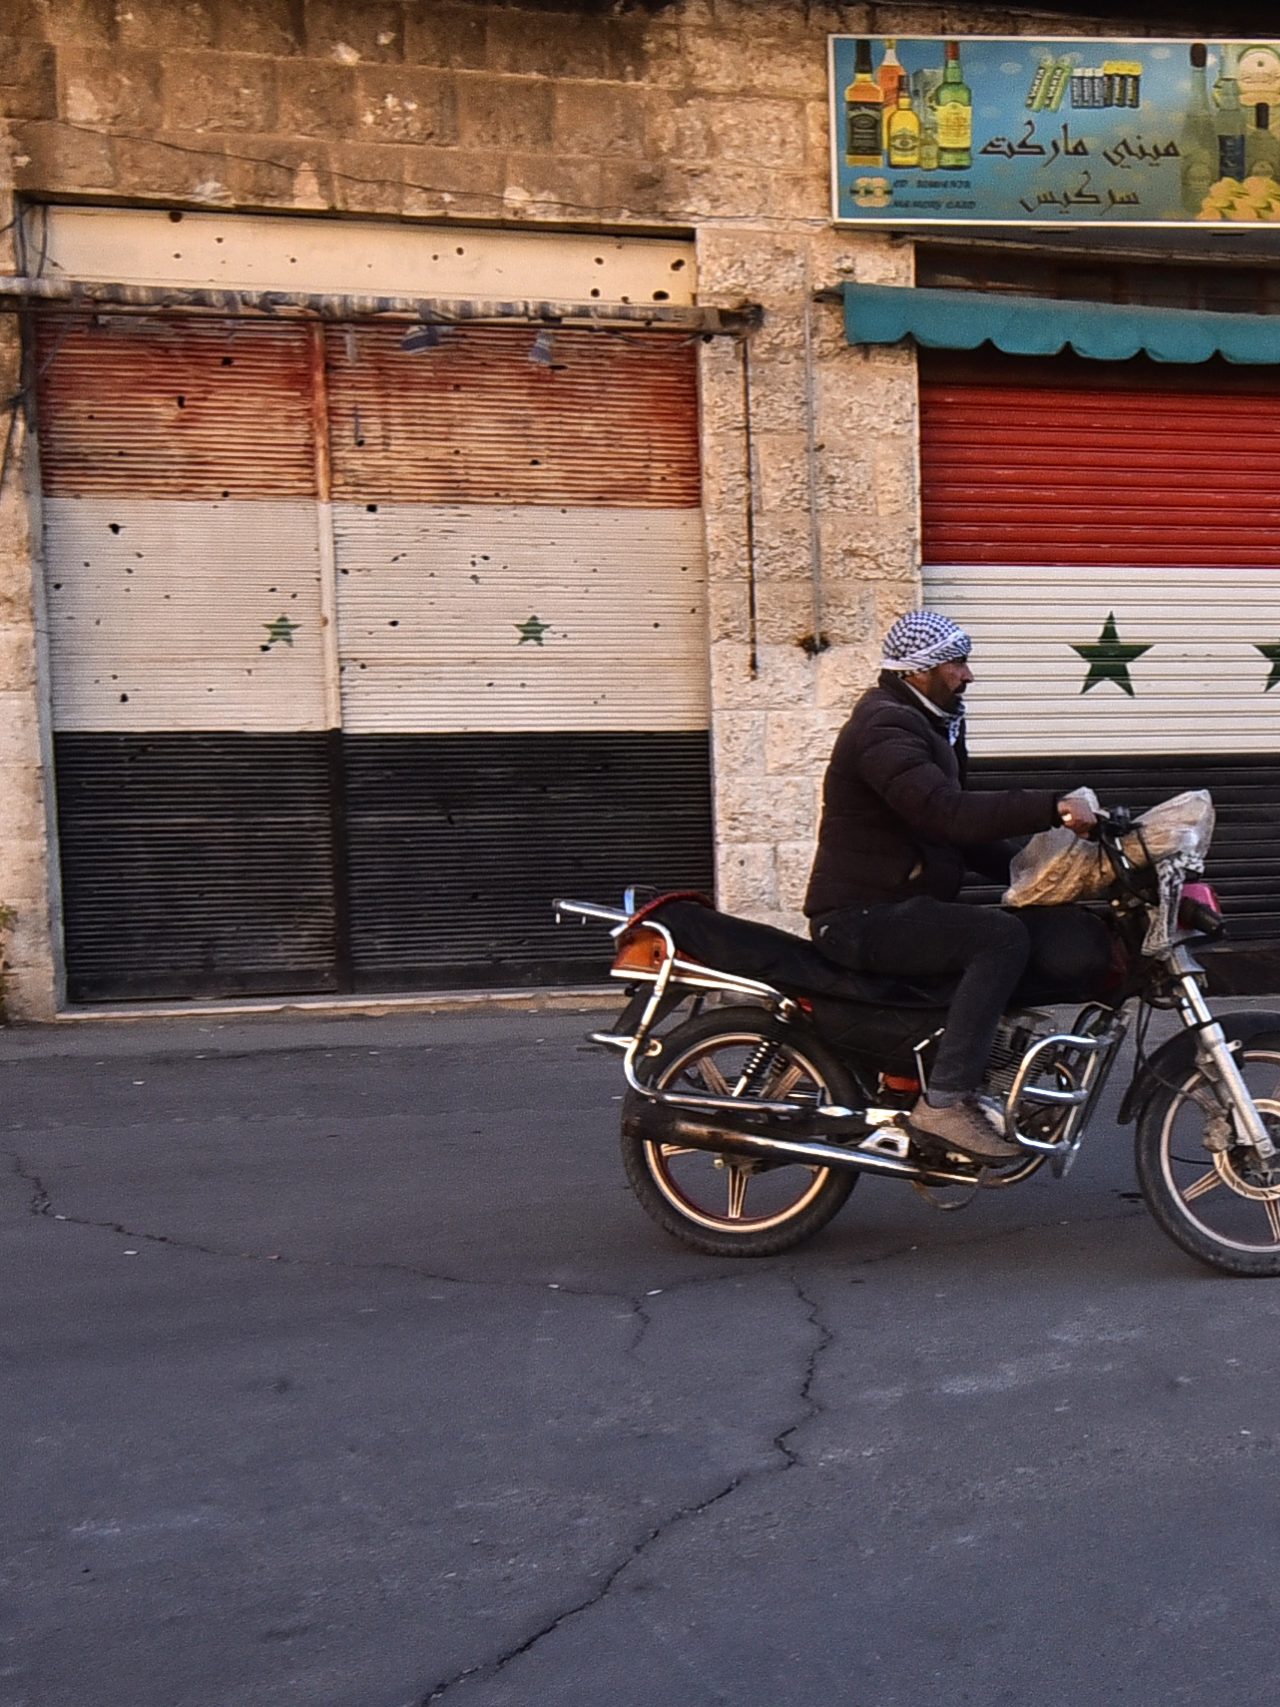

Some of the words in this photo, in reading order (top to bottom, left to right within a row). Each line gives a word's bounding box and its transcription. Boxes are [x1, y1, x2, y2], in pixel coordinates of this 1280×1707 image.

[979, 120, 1089, 168] ماركت
[1102, 135, 1180, 169] ميني
[1019, 170, 1140, 216] سركيس
